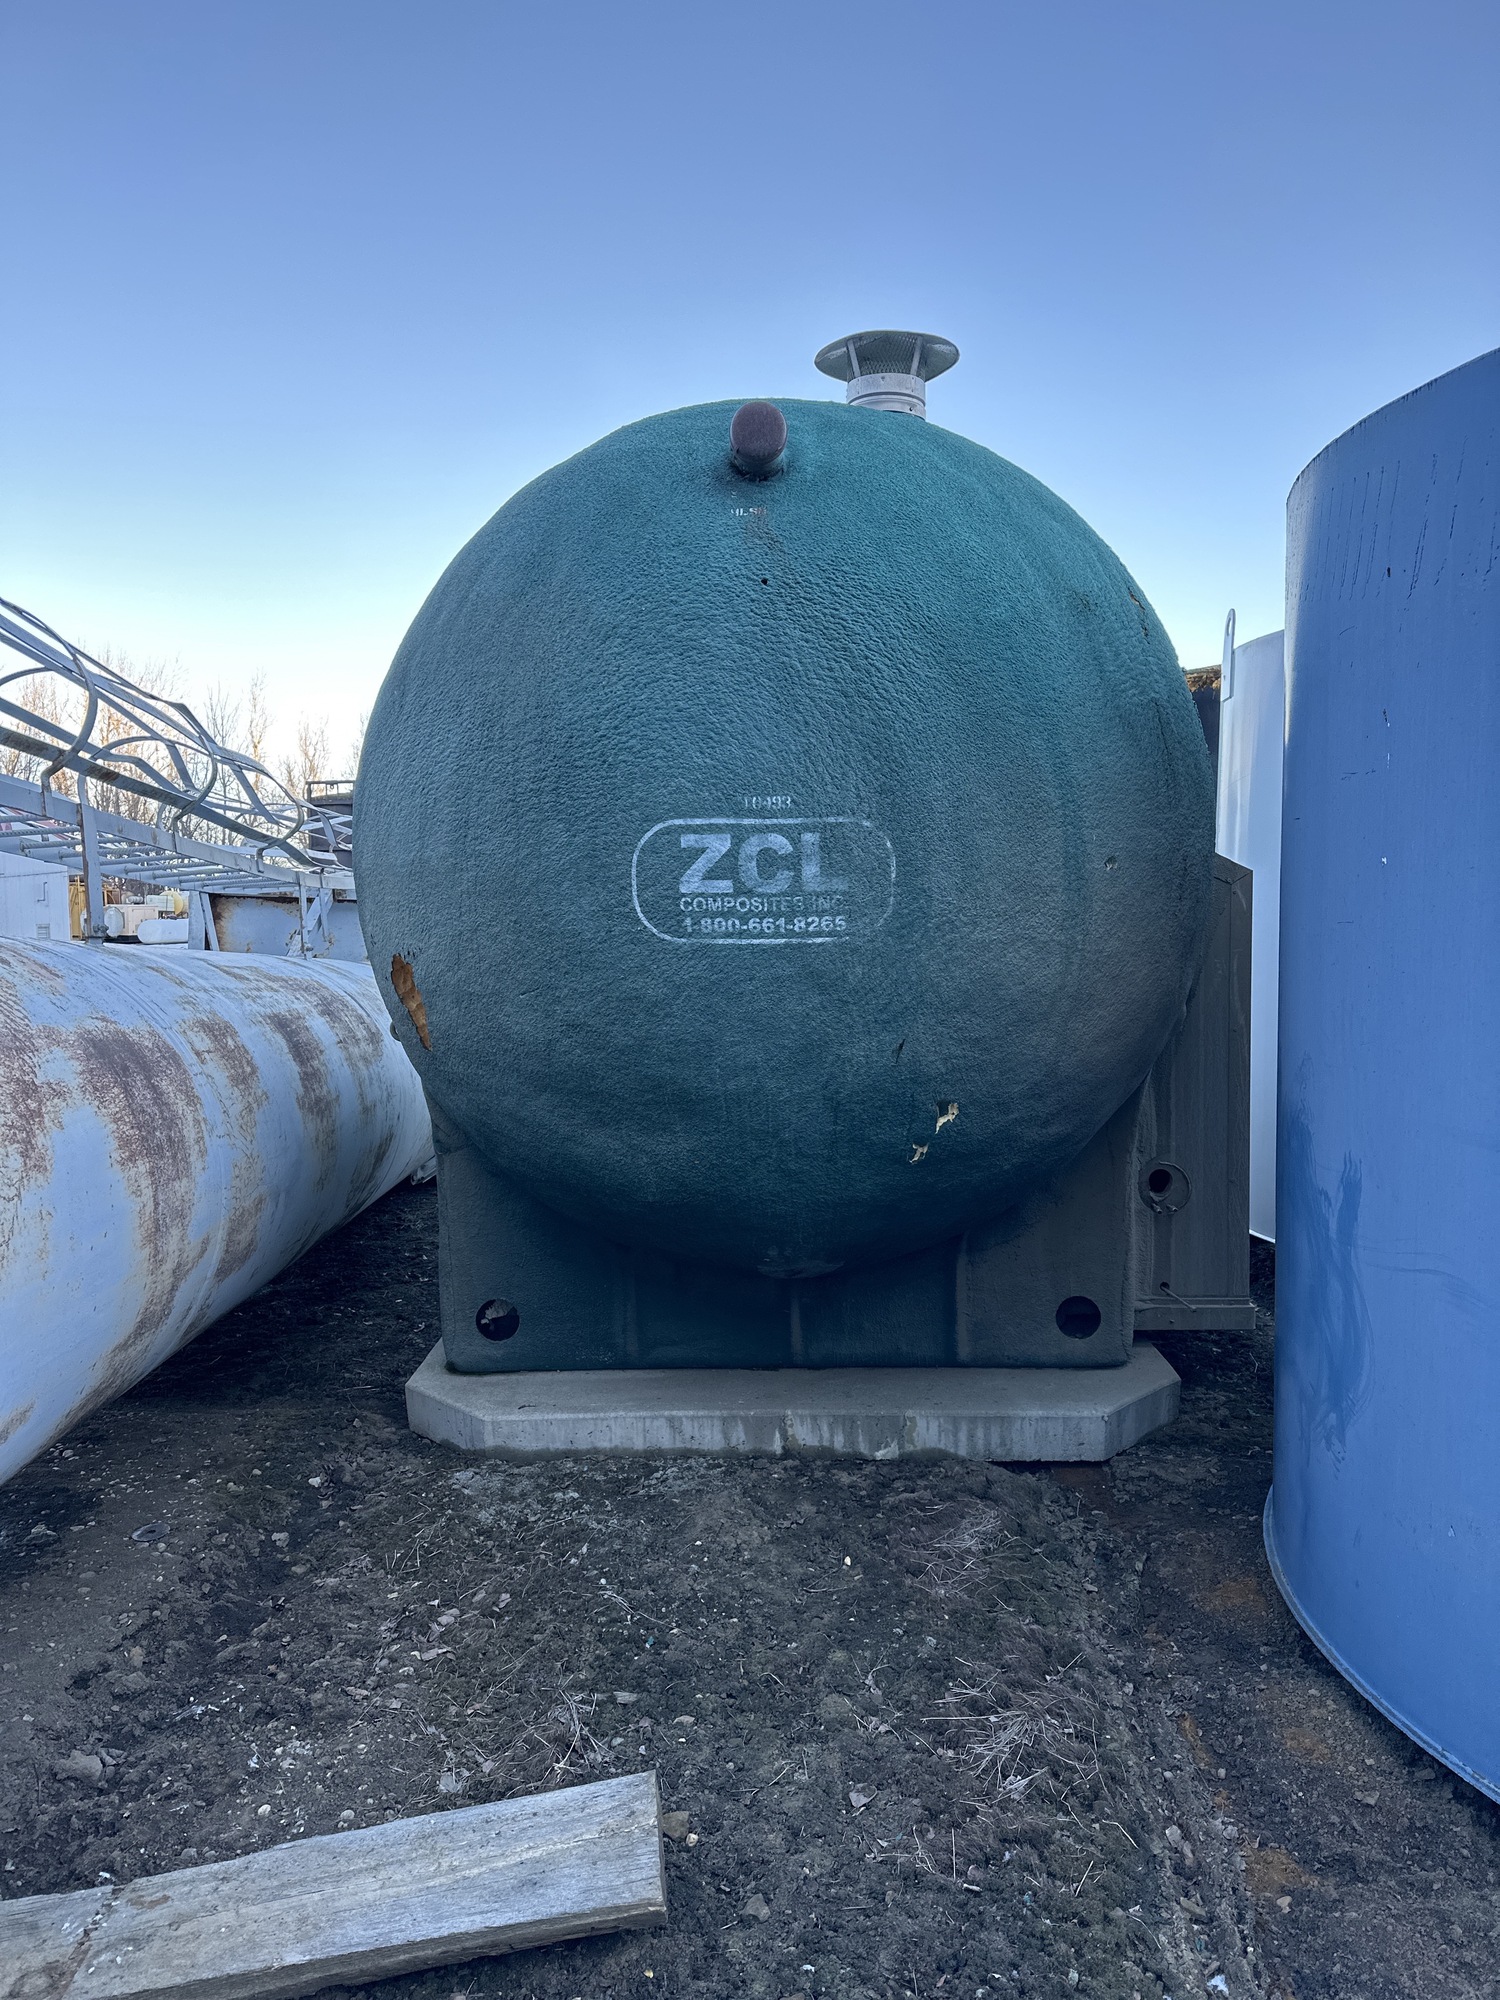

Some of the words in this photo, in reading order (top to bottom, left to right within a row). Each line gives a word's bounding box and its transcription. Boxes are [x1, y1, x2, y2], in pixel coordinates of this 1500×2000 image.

[679, 833, 849, 894] ZCL
[679, 897, 804, 912] COMPOSITES
[683, 916, 847, 932] 1-800-661-8265
